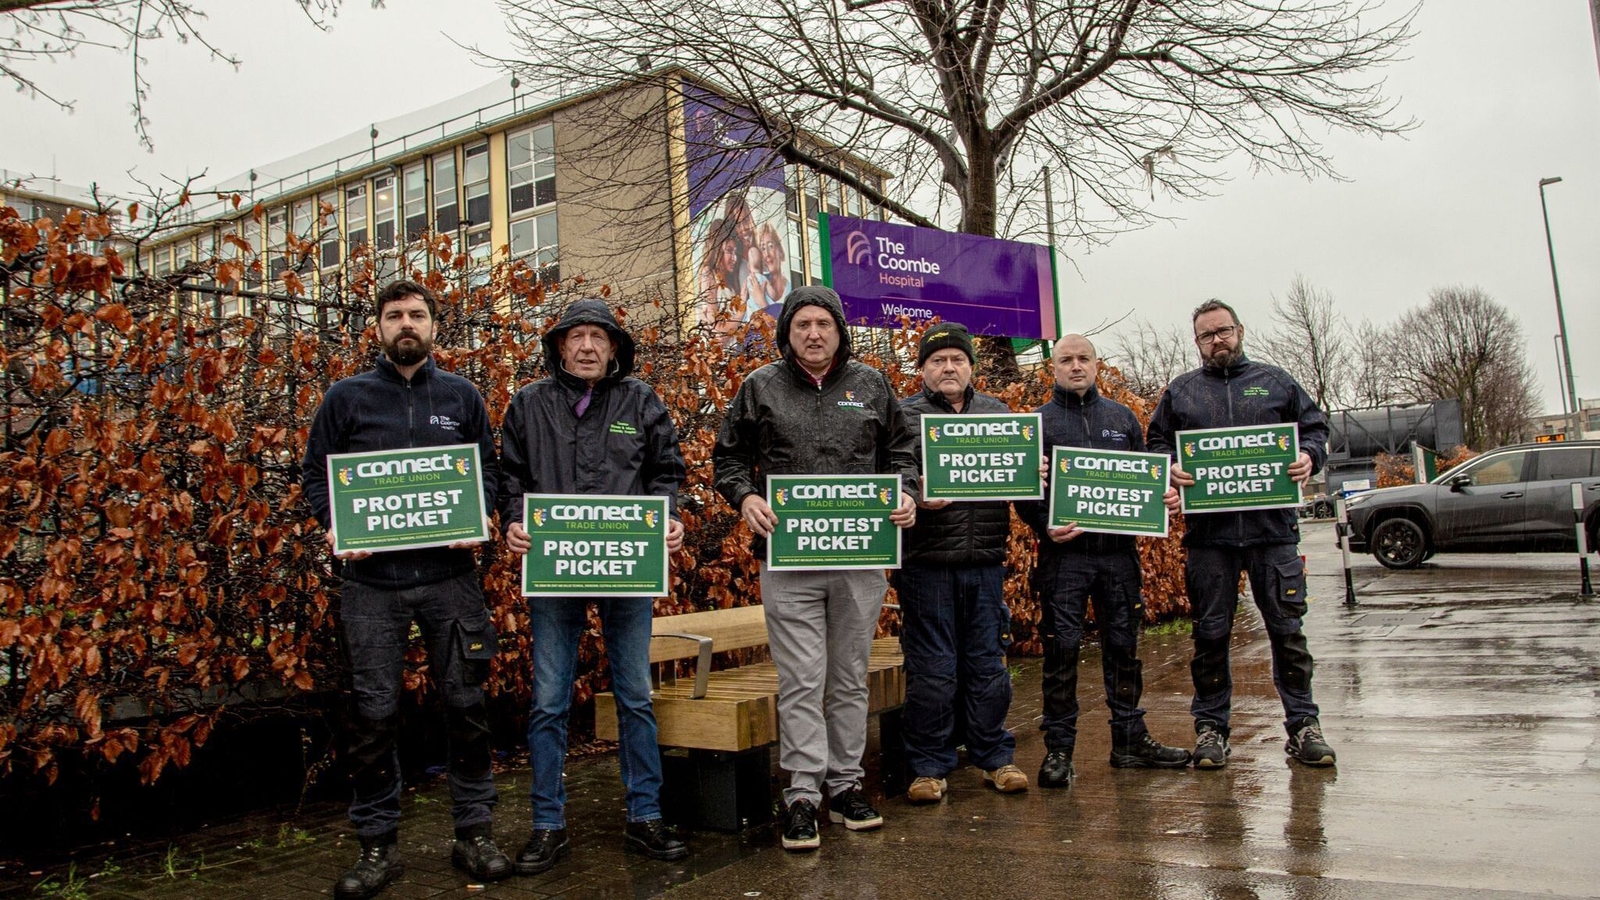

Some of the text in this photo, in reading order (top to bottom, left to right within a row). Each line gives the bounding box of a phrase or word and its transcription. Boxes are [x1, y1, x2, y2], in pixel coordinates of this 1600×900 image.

[875, 236, 905, 255] The
[878, 254, 940, 275] Coombe
[879, 272, 924, 289] Hospital
[881, 303, 933, 319] Welcome
[943, 420, 1020, 437] connect
[983, 436, 1009, 444] UNION
[1198, 431, 1276, 451] connect
[357, 453, 453, 478] connect
[939, 452, 1026, 467] PROTEST
[1073, 456, 1149, 474] connect
[373, 473, 441, 486] TRADE UNION
[950, 469, 1017, 483] PICKET
[1085, 470, 1138, 480] TRADE UNION
[1195, 462, 1283, 480] PROTEST
[791, 482, 877, 499] connect
[1067, 484, 1153, 503] PROTEST
[1206, 478, 1274, 495] PICKET
[352, 489, 463, 514] PROTEST
[1076, 501, 1143, 518] PICKET
[367, 509, 452, 531] PICKET
[550, 503, 642, 521] connect
[565, 521, 629, 530] TRADE UNION
[786, 518, 883, 533] PROTEST
[543, 540, 649, 556] PROTEST
[797, 535, 873, 551] PICKET
[555, 560, 637, 575] PICKET
